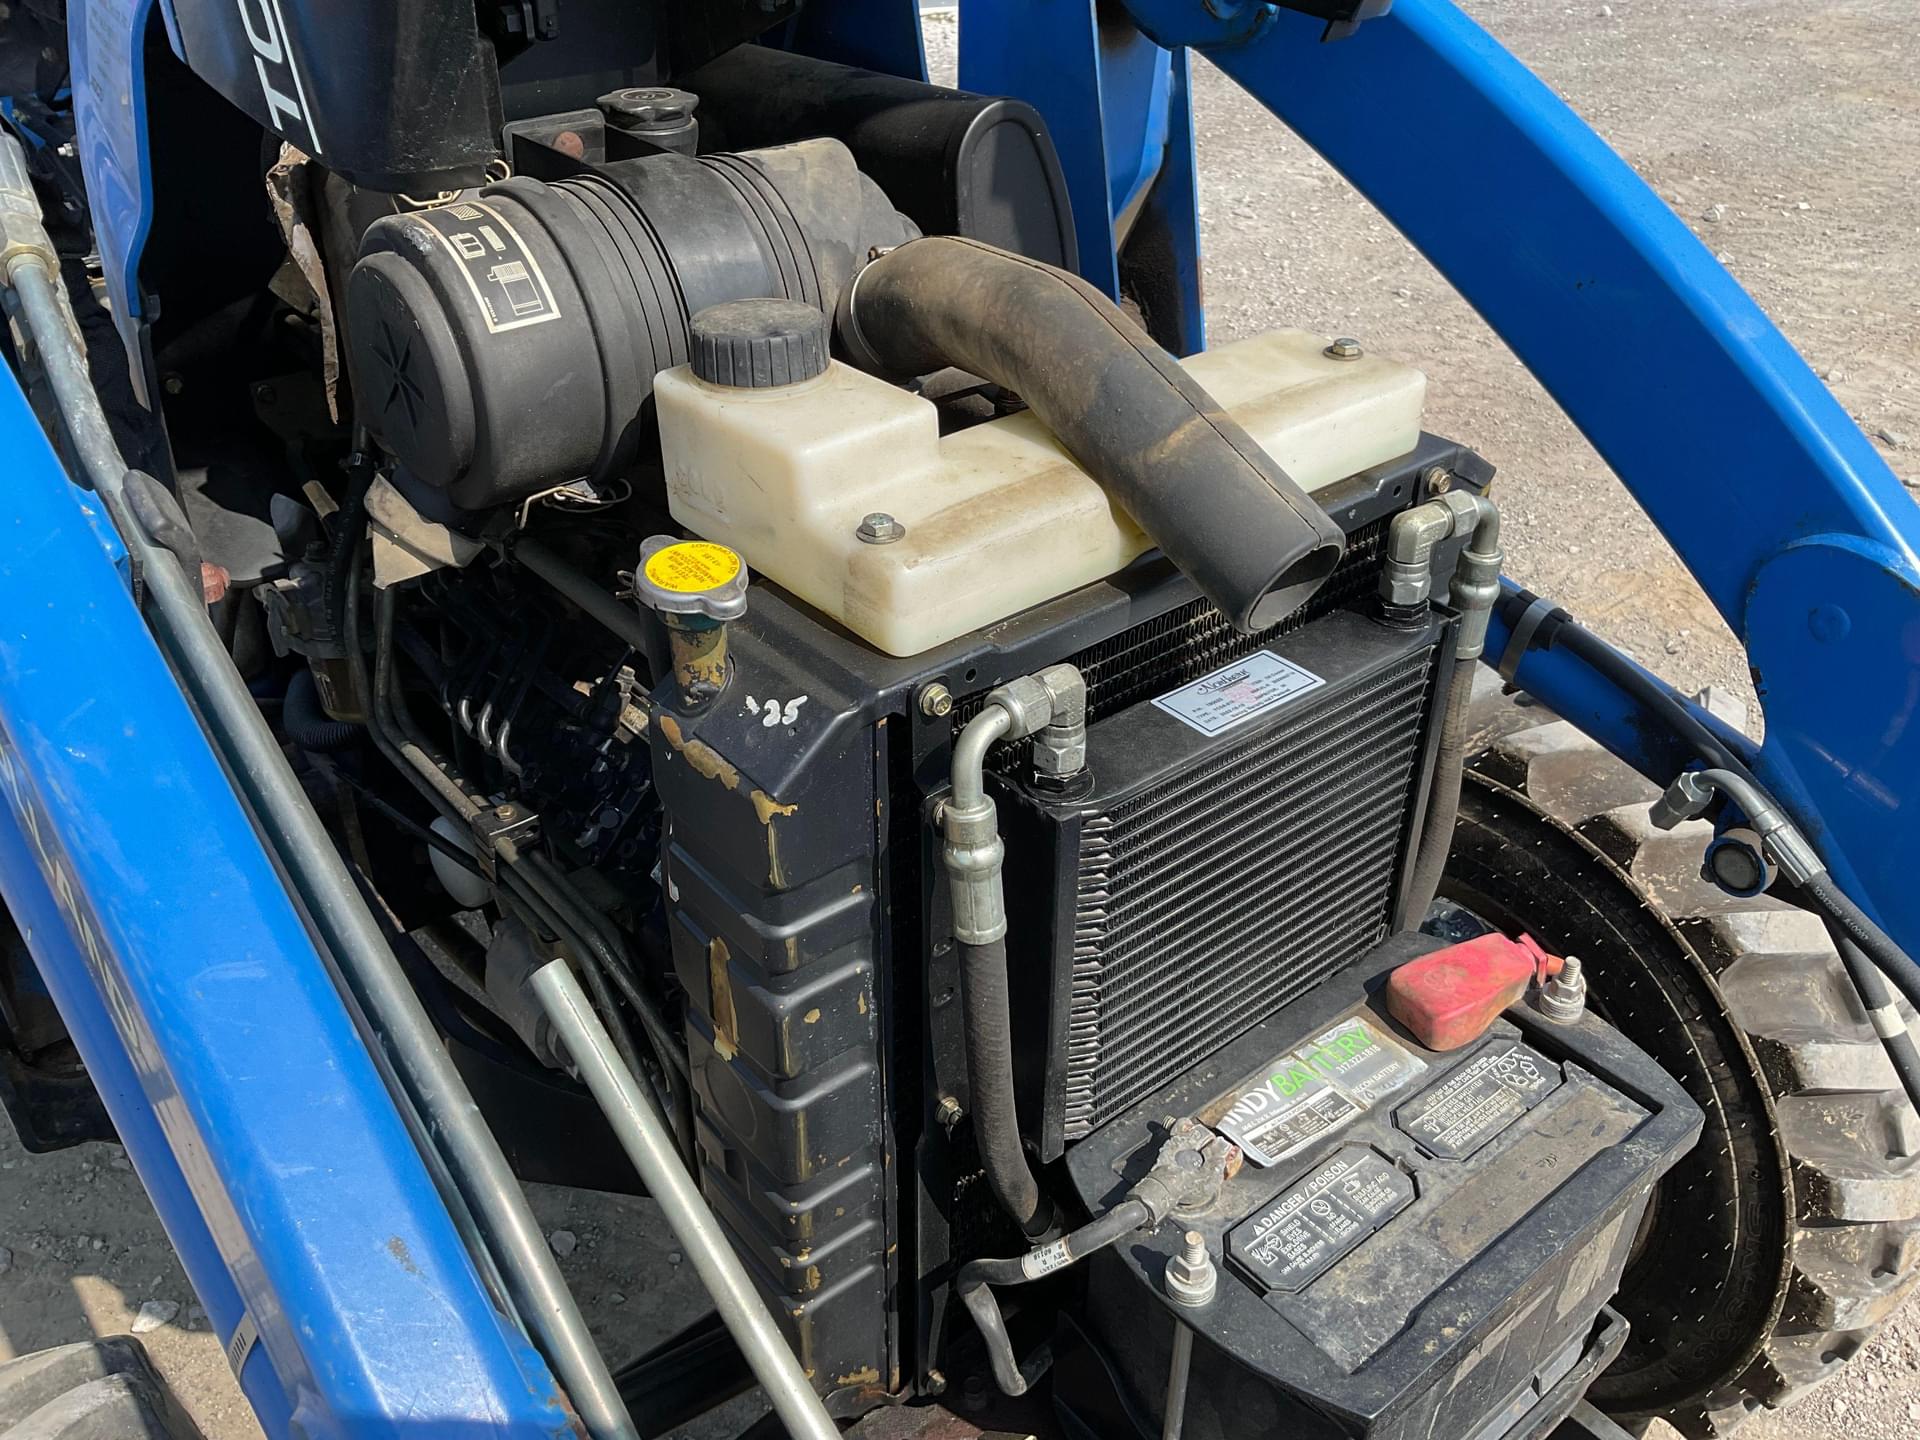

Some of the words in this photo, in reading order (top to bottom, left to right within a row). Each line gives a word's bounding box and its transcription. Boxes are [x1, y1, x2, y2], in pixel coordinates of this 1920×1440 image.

[1260, 1192, 1305, 1227] DANGER
[1308, 1160, 1349, 1191] POISON
[1280, 1219, 1301, 1236] SHIELD
[1287, 1228, 1302, 1241] EYES
[1281, 1231, 1311, 1254] EXPLOSIVE
[1288, 1243, 1306, 1260] GASES
